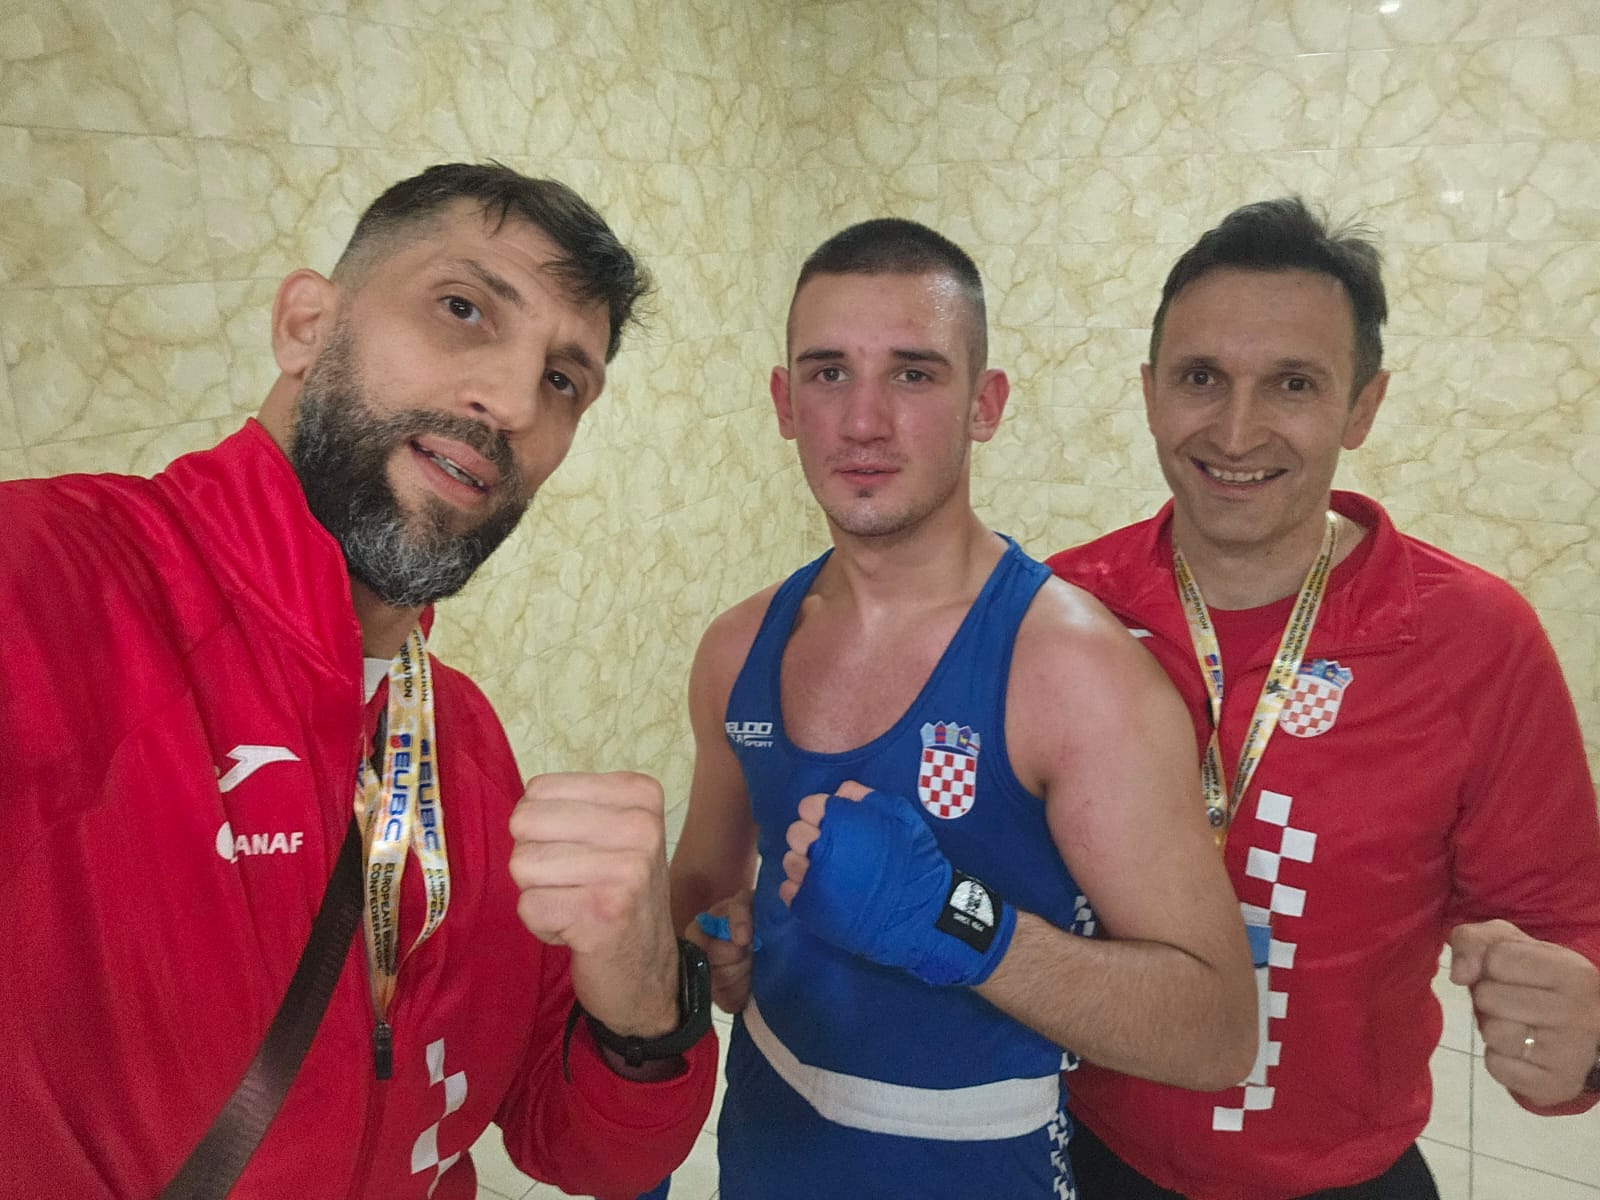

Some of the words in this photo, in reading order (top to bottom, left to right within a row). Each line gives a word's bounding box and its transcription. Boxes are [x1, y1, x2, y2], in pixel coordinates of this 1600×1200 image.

[384, 752, 411, 841] EUBC
[419, 762, 440, 850] EUBC
[230, 831, 304, 864] ANAF
[369, 862, 383, 969] CONFEDERATION
[380, 863, 396, 929] EUROPEAN
